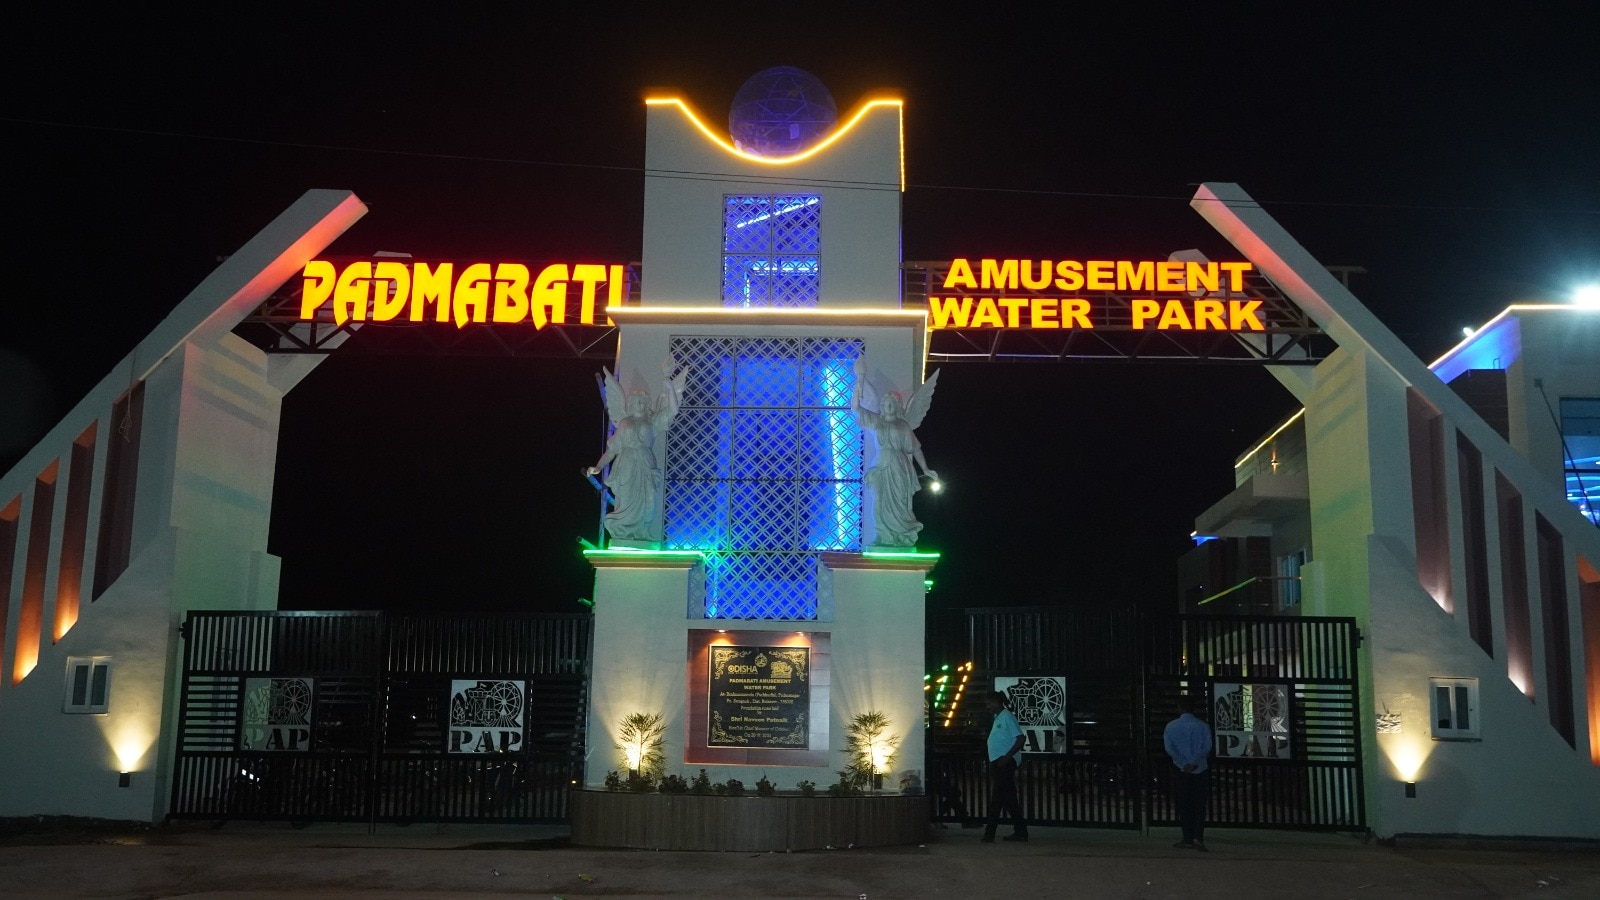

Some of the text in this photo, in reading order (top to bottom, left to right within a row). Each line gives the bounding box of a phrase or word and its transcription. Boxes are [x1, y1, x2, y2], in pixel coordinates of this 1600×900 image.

[943, 258, 1252, 292] AMUSEMENT
[300, 260, 624, 331] PADMABATI
[929, 297, 1265, 331] WATER PARK
[727, 664, 758, 673] ODISHA
[450, 730, 522, 752] PAP
[1021, 729, 1065, 752] AP
[1216, 734, 1289, 758] PAP
